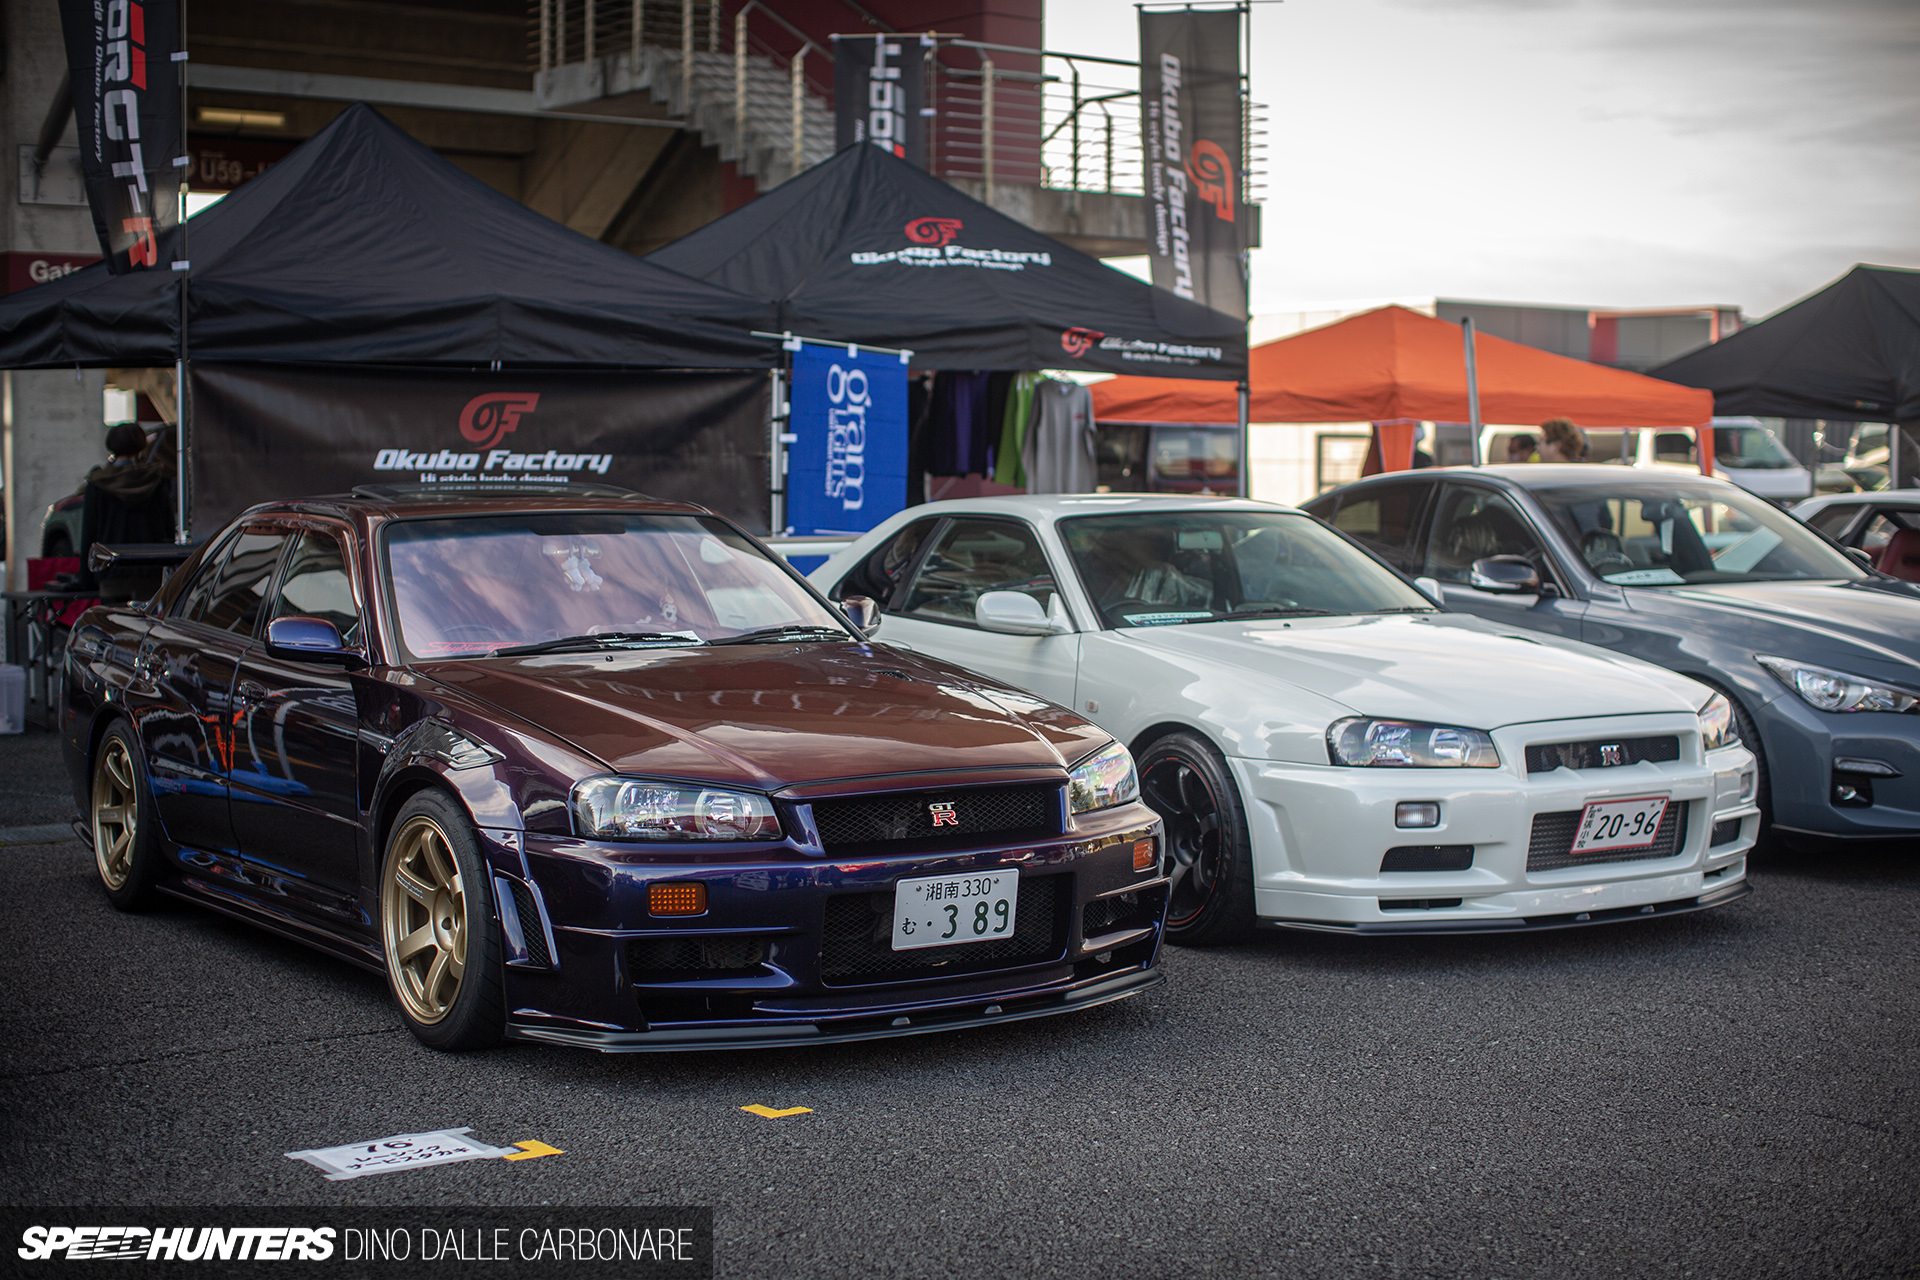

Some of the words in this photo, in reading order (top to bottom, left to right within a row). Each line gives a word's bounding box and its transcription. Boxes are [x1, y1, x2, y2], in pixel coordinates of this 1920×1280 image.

[1160, 53, 1184, 161] Okubo
[945, 245, 1051, 266] Factory
[1166, 166, 1195, 300] Factory
[373, 449, 480, 470] Okubo
[484, 449, 613, 474] Factory
[827, 363, 873, 512] gram
[831, 407, 848, 498] LIGHTS
[1592, 810, 1661, 841] 20-96
